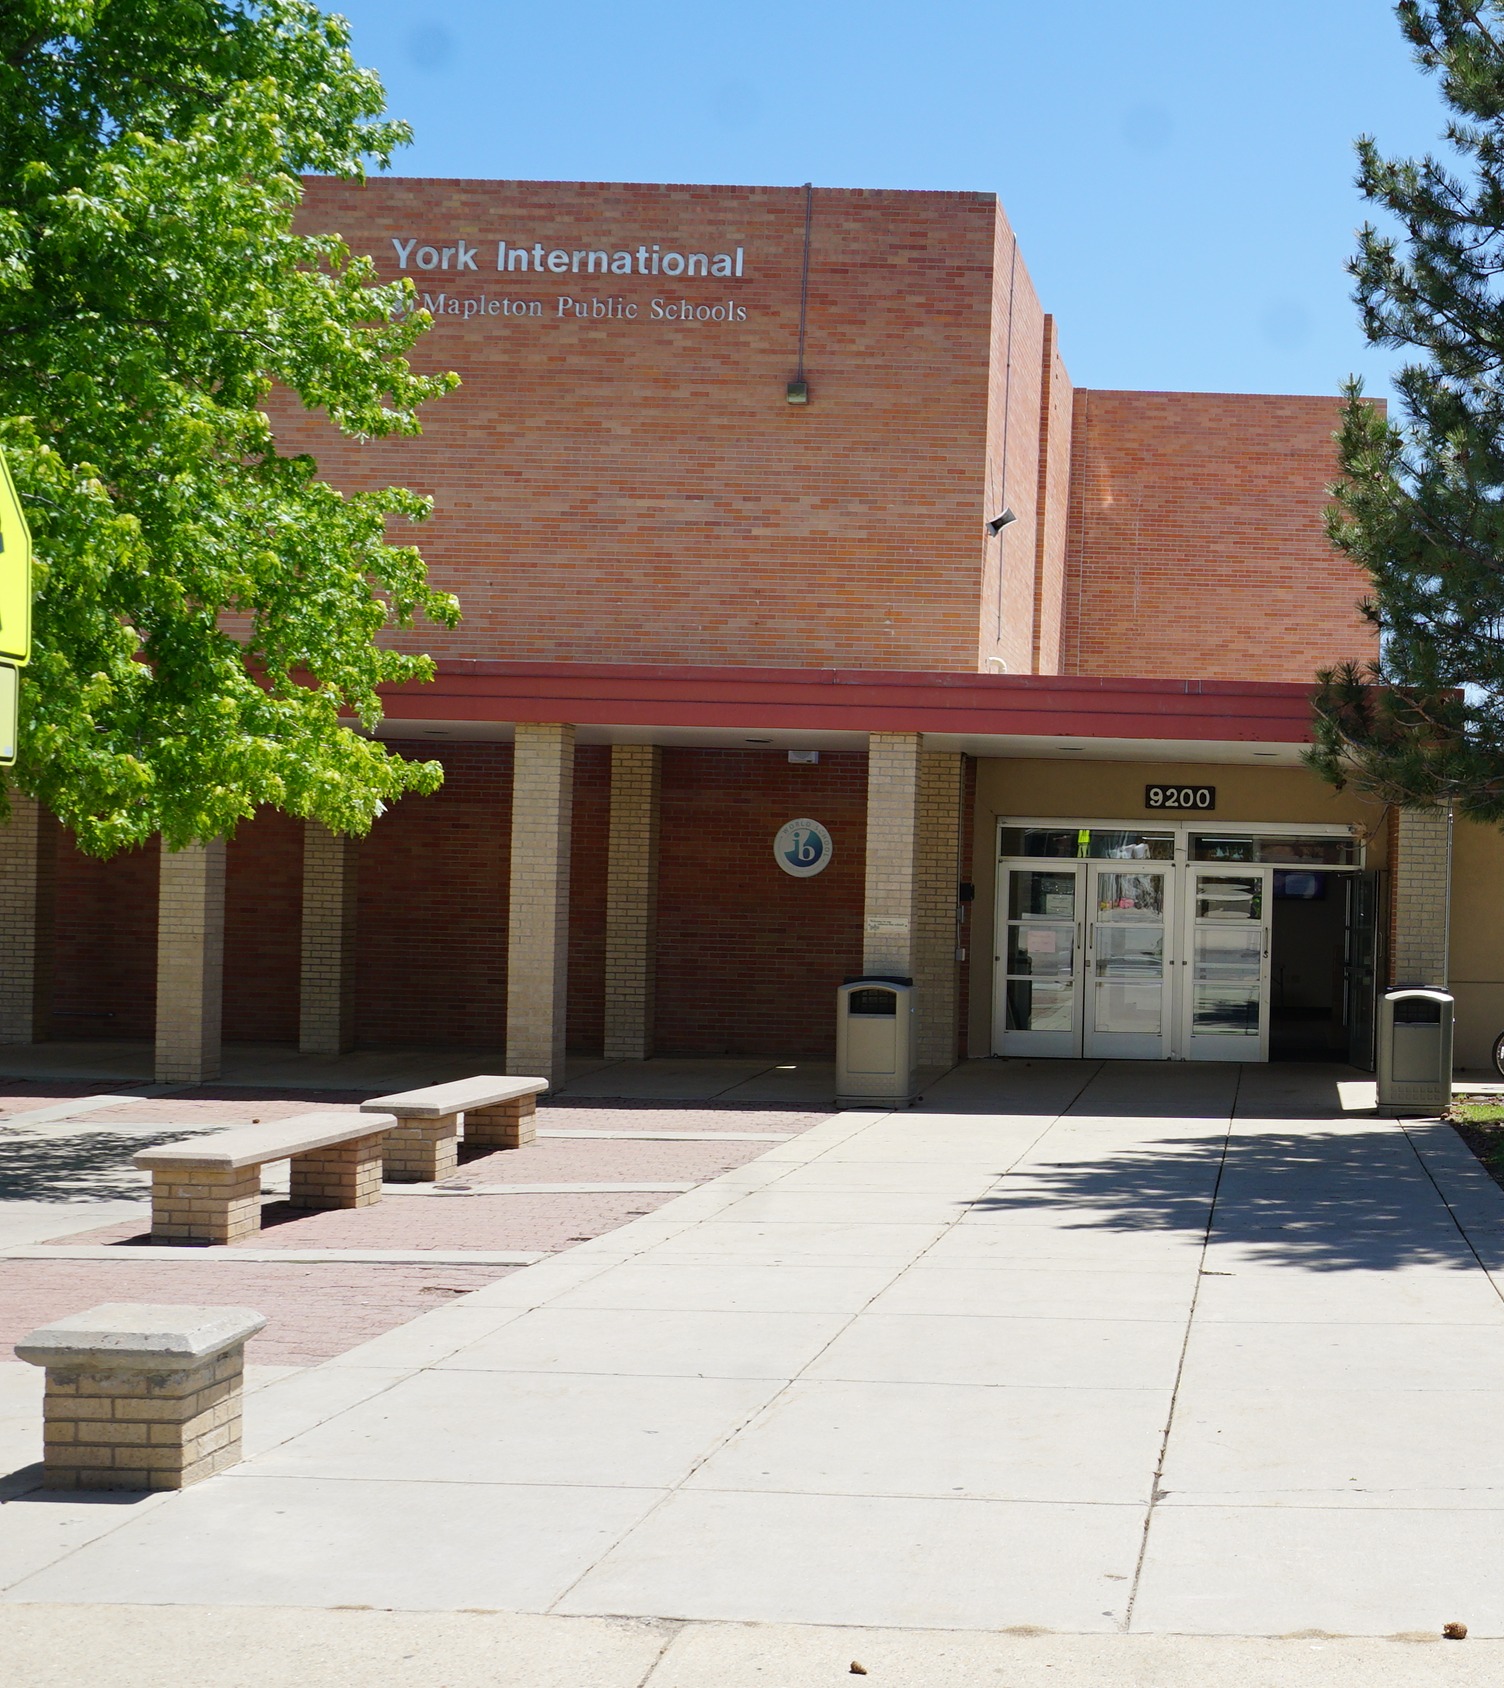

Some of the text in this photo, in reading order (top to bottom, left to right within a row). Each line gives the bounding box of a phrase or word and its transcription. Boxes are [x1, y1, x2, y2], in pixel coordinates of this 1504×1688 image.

[391, 238, 745, 277] York International
[422, 292, 747, 322] Mapleton Public Schools
[1149, 787, 1210, 808] 9200
